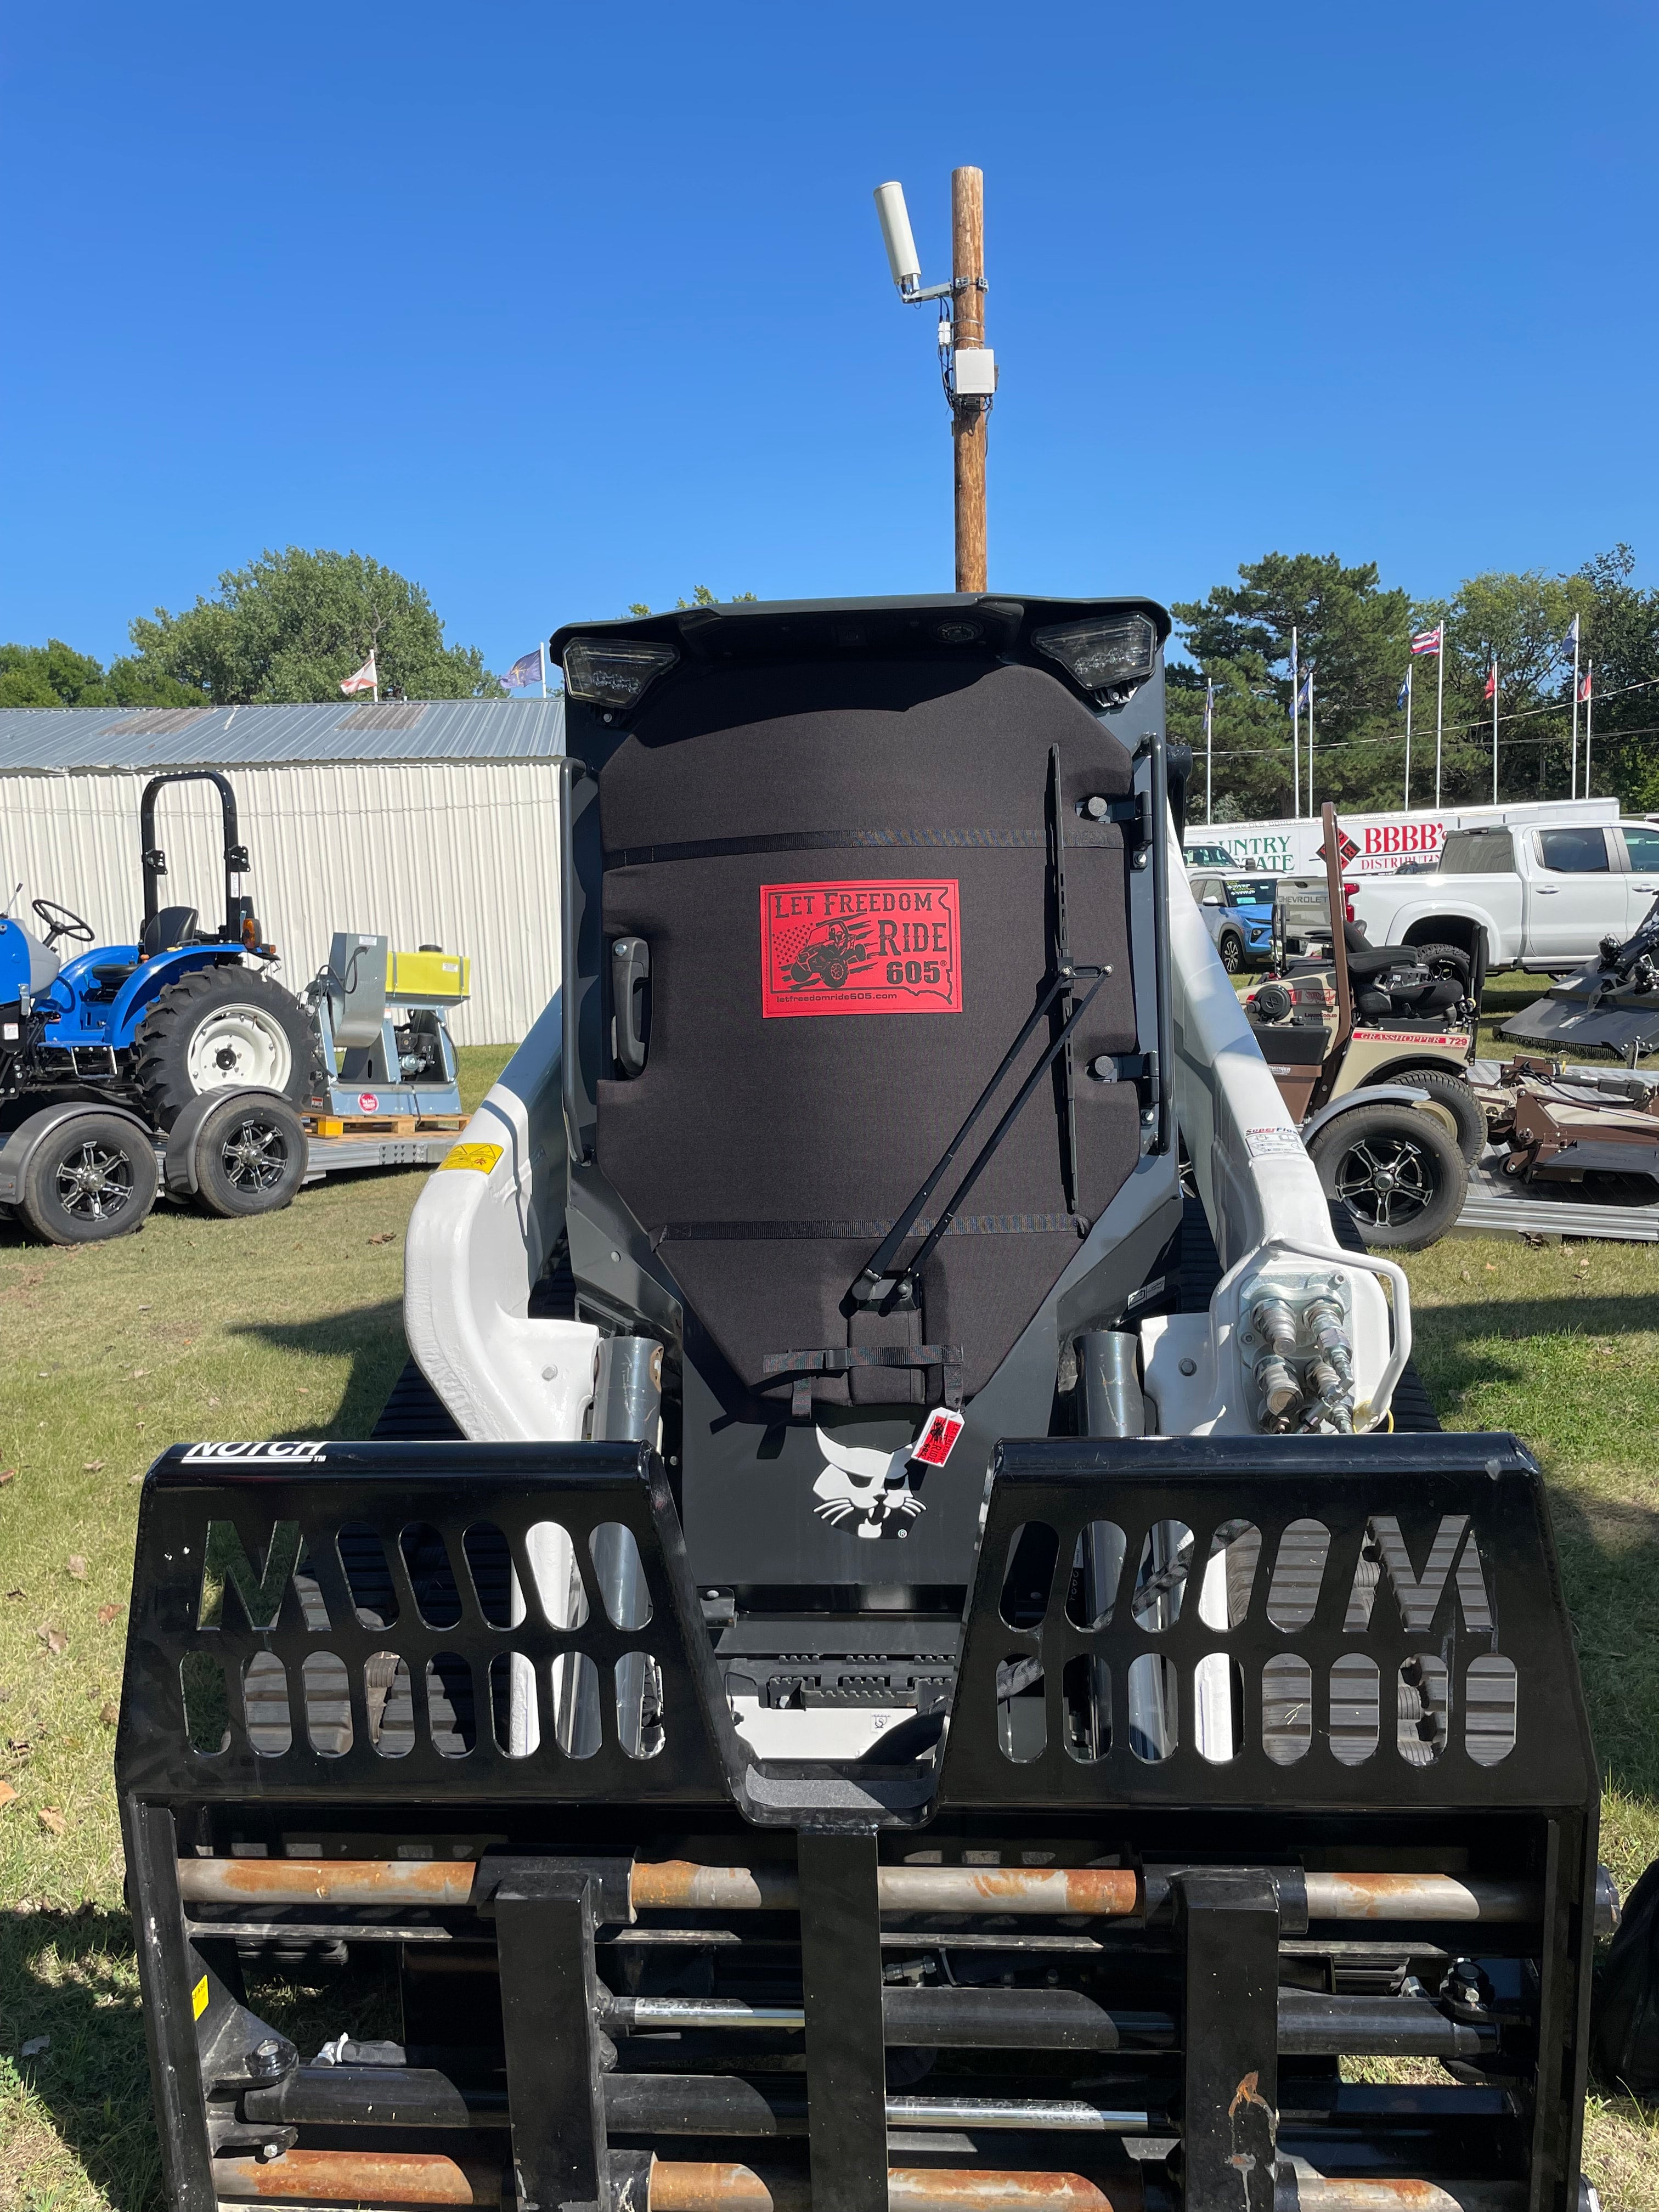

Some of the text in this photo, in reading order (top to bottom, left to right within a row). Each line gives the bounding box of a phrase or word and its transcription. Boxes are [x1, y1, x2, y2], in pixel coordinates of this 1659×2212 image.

[775, 892, 933, 918] LET FREEDOM
[1278, 895, 1328, 904] CHEVROLET
[878, 919, 947, 956] RIDE
[776, 992, 898, 1003] letfreedomride605.com
[1360, 1032, 1441, 1044] GRASSHOPPER
[186, 1441, 328, 1457] NOTCH
